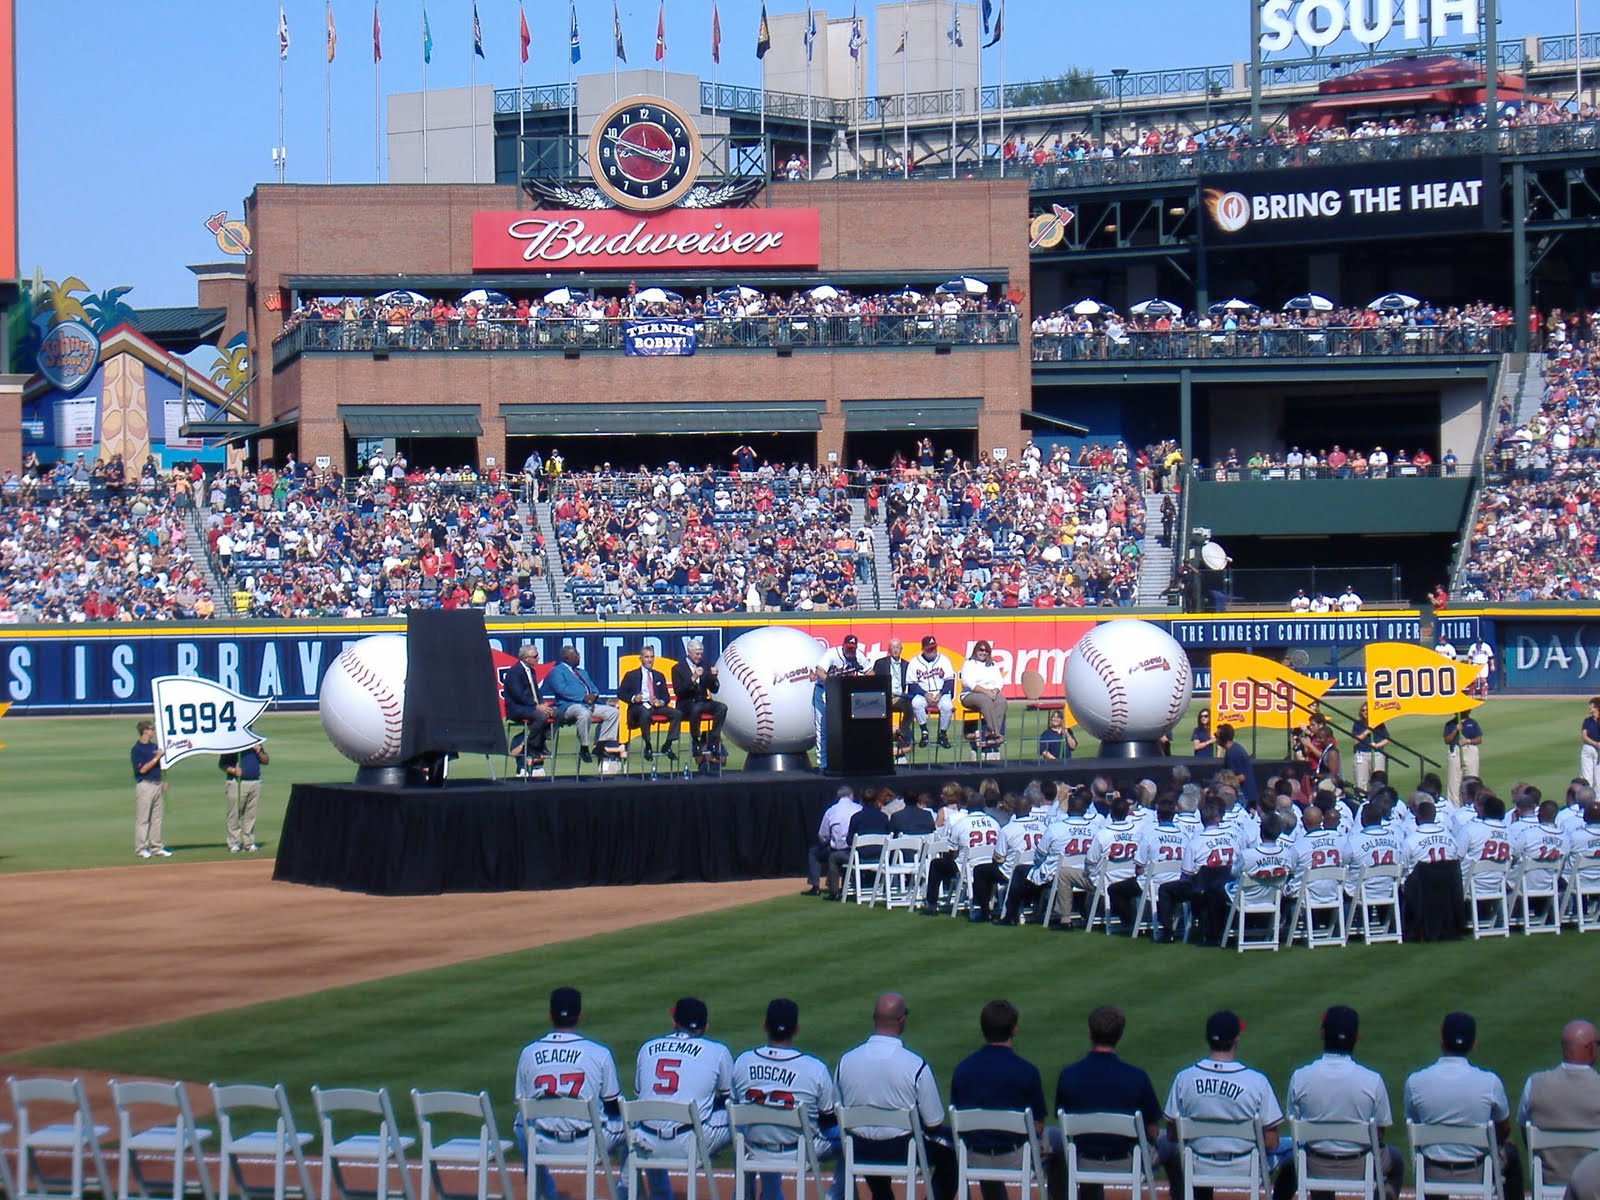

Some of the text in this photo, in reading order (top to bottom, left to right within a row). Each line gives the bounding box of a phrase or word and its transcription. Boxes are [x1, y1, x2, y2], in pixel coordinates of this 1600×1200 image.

[622, 114, 630, 124] 11
[640, 108, 649, 119] 12
[1253, 180, 1482, 221] BRING THE HEAT
[508, 218, 784, 261] Budweiser
[626, 323, 694, 338] THANKS
[634, 337, 687, 349] BOBBY!
[1181, 622, 1471, 642] THE LONGEST CONTINUOUSLY OPER ATING
[1517, 624, 1600, 679] DAS
[75, 644, 135, 700] IS
[177, 641, 350, 696] BRAV
[1373, 666, 1456, 699] 2000
[1217, 679, 1295, 712] 1999
[165, 701, 236, 735] 1994
[1311, 838, 1336, 849] JUSTICE
[1207, 848, 1234, 867] 47
[534, 1048, 582, 1065] BEACHY
[648, 1041, 703, 1058] FREEMAN
[653, 1058, 682, 1095] 5
[749, 1064, 796, 1087] BOSCAN
